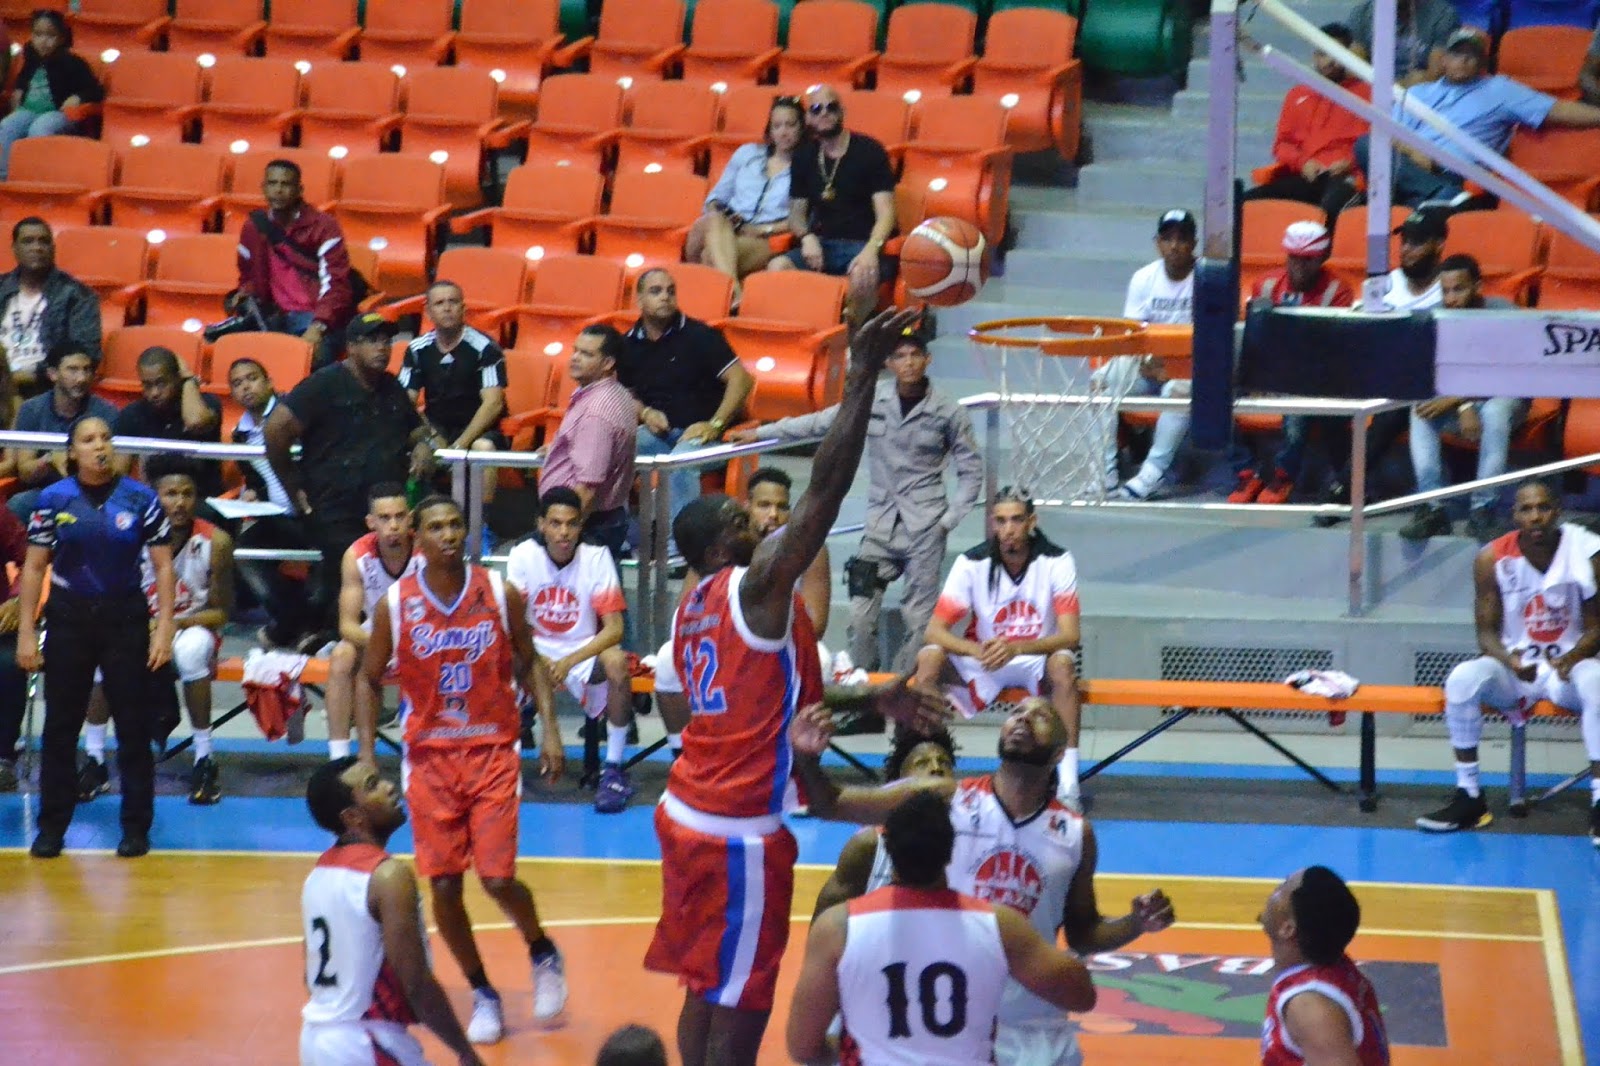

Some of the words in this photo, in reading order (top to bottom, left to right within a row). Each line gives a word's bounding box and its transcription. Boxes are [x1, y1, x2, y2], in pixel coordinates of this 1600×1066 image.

[438, 661, 472, 694] 20
[684, 637, 727, 715] 12
[312, 916, 338, 987] 2
[881, 961, 969, 1038] 10
